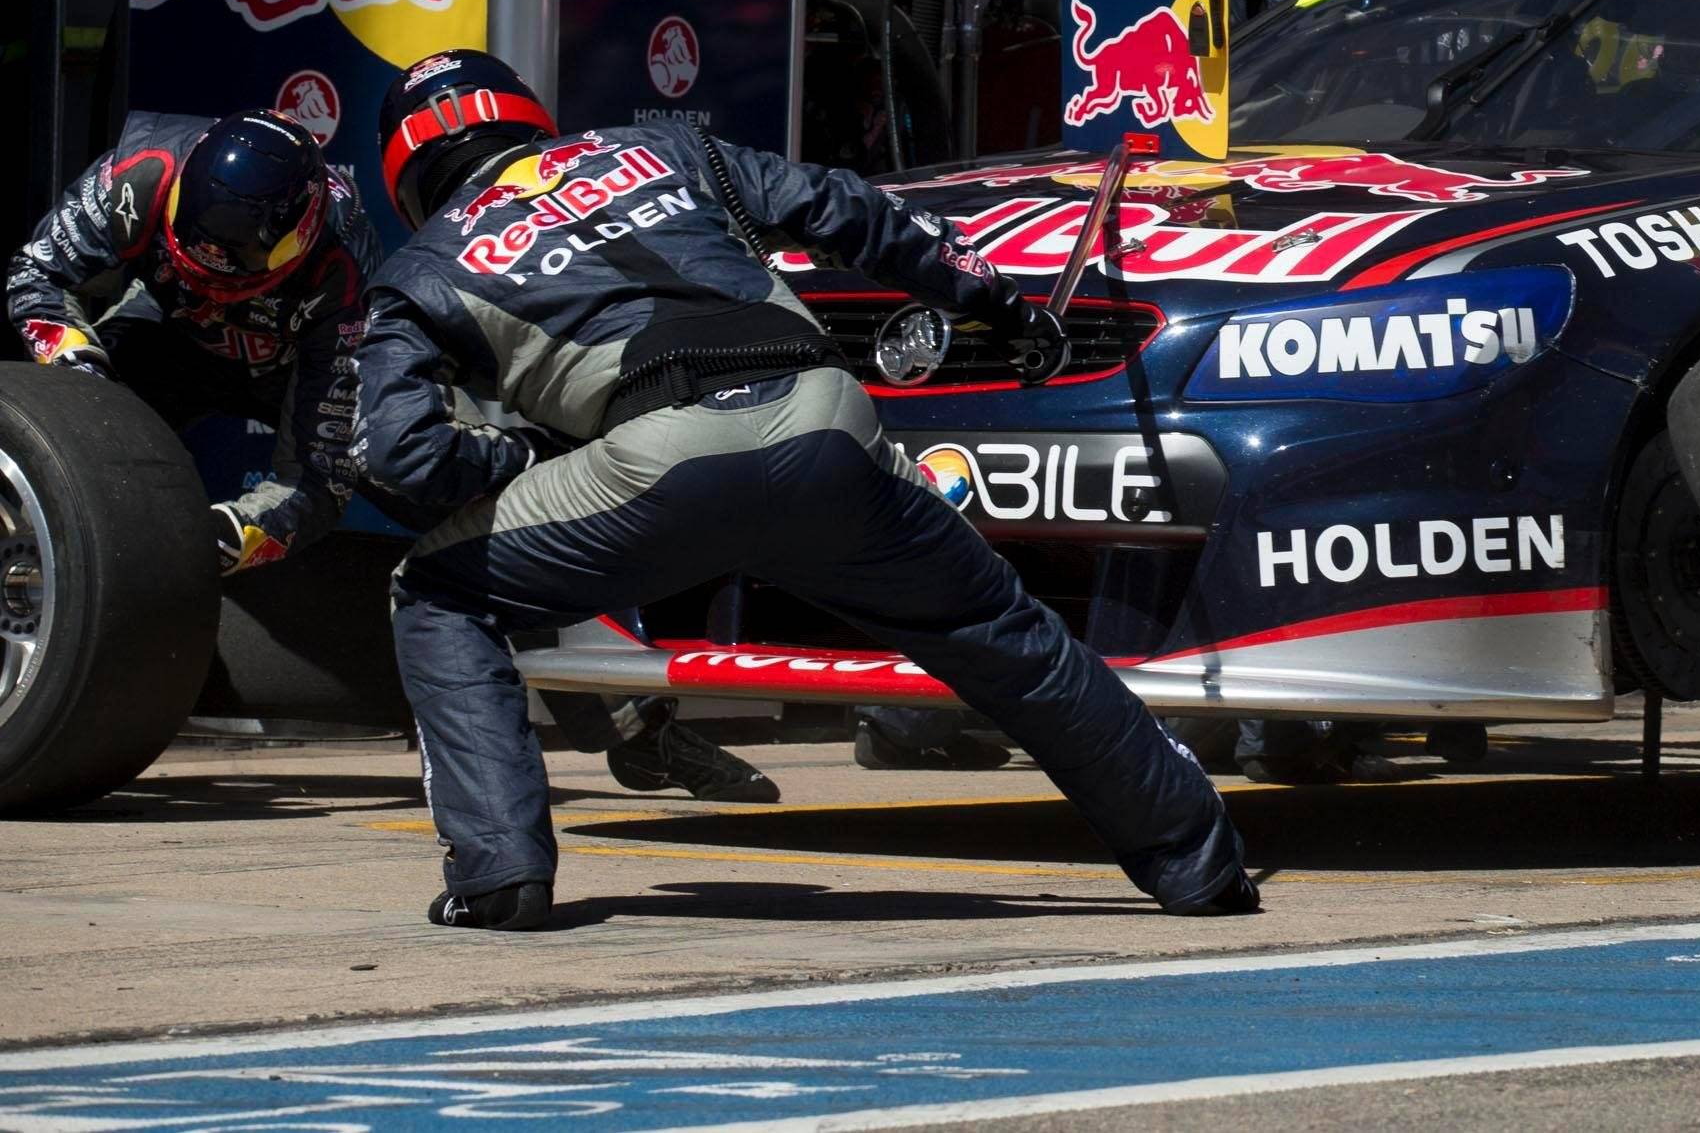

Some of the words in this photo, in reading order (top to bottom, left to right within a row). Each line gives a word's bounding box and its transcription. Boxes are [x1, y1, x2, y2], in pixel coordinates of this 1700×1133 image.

[634, 108, 712, 128] HOLDEN
[456, 194, 578, 275] Red
[553, 146, 676, 220] Bull
[1218, 298, 1536, 380] KOMATSU
[895, 443, 1173, 523] OBILE
[1257, 513, 1566, 589] HOLDEN
